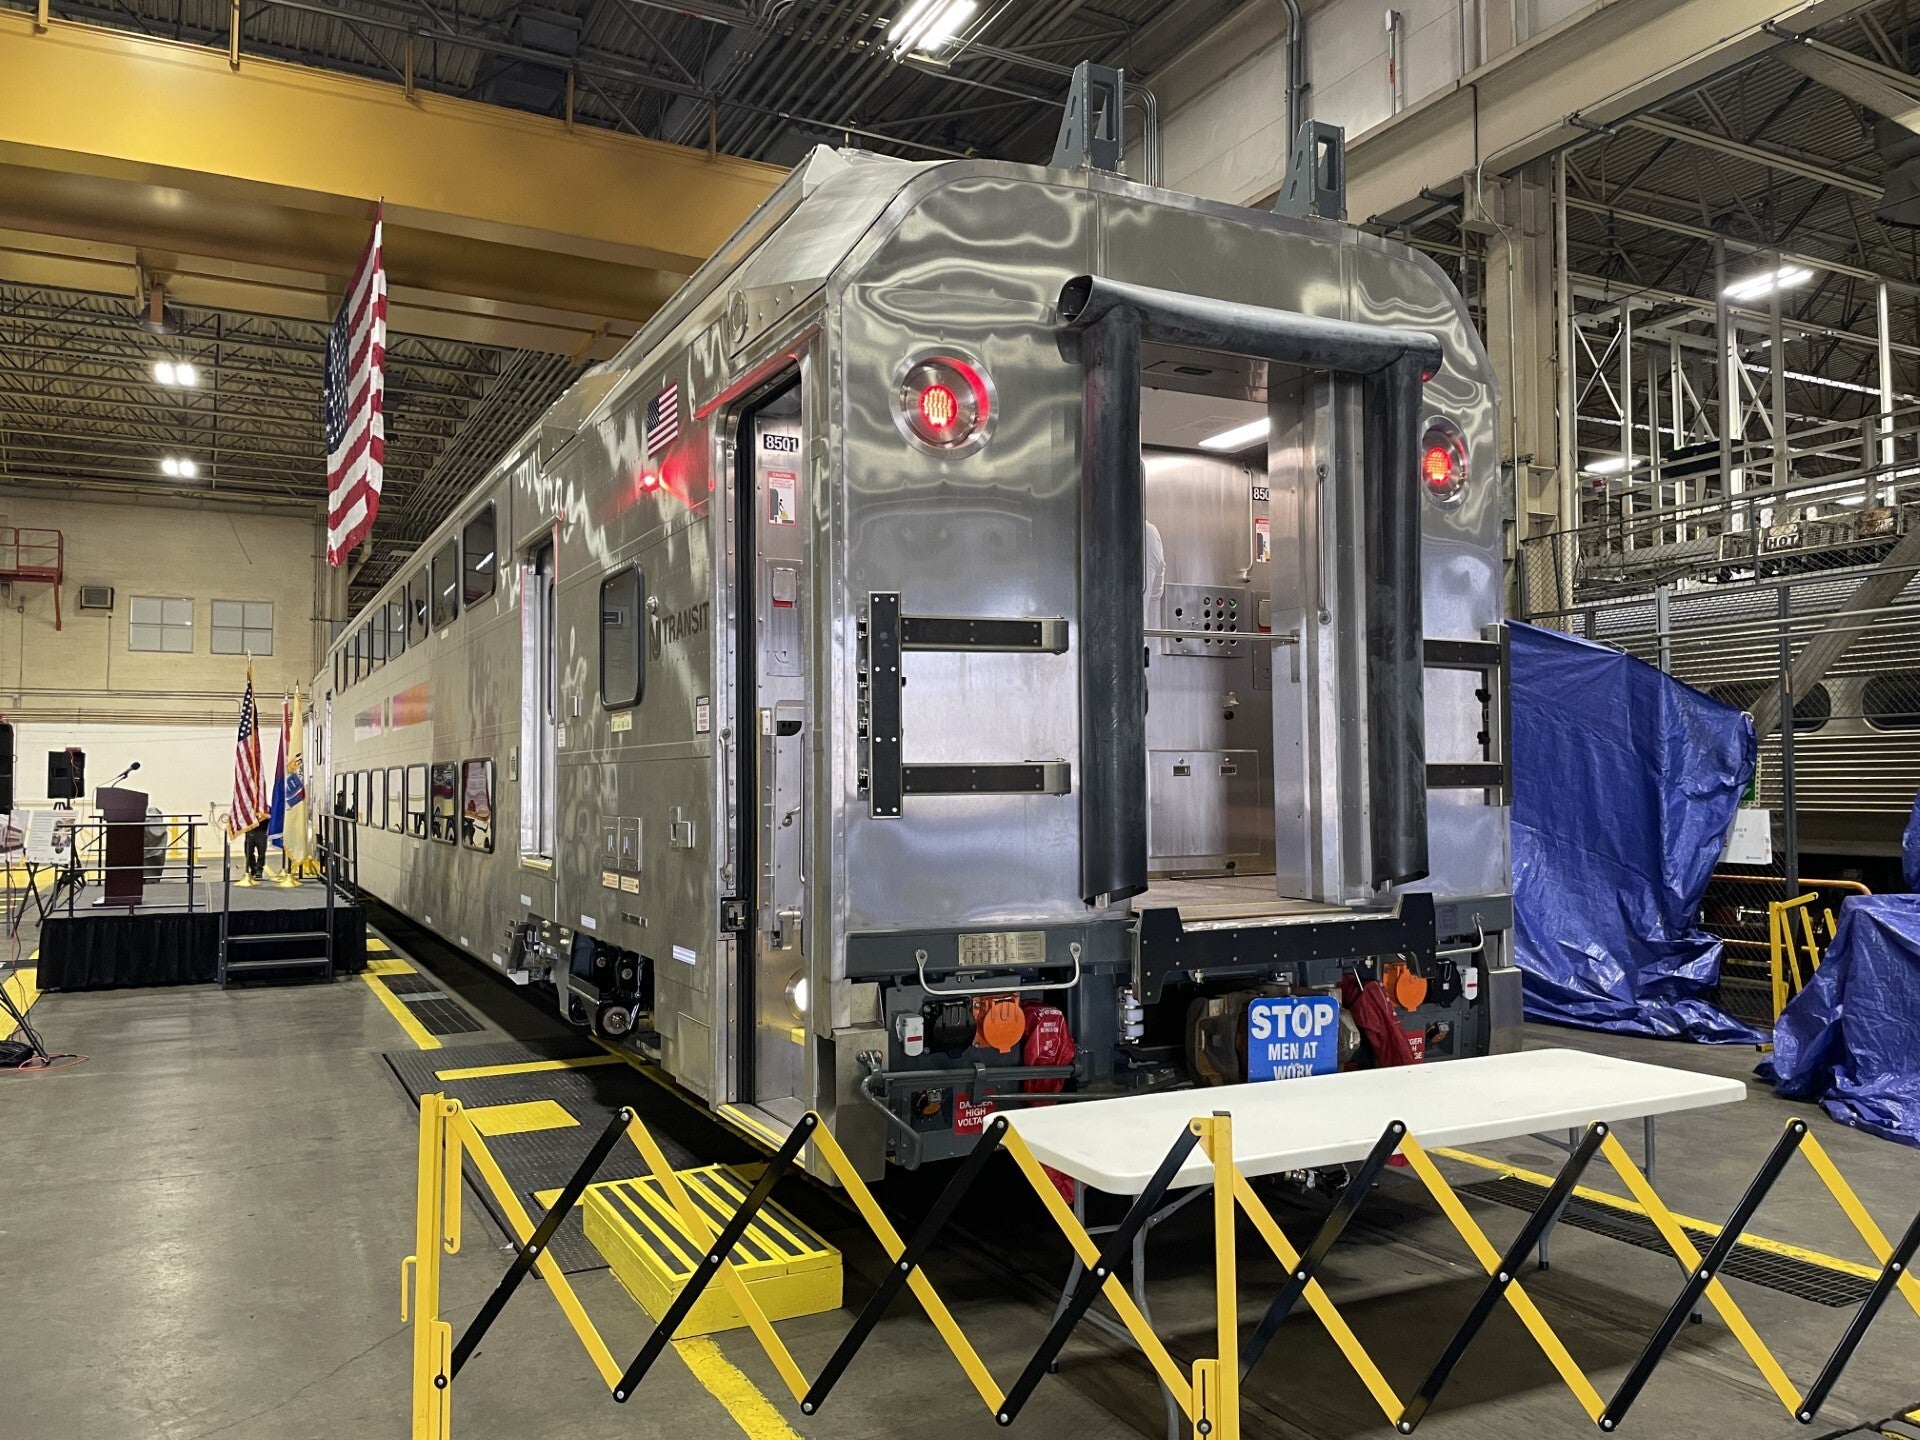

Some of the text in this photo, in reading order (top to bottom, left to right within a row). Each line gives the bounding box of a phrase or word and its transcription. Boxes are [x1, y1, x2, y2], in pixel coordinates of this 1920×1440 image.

[765, 435, 798, 452] 8501
[1253, 487, 1270, 500] 850
[1767, 534, 1799, 549] HOT
[662, 601, 710, 646] TRANSIT
[1251, 1004, 1334, 1040] STOP
[1268, 1041, 1318, 1061] MEN AT
[1273, 1063, 1313, 1080] WORK
[965, 1107, 986, 1117] HIGH
[957, 1116, 983, 1127] VOLTA
